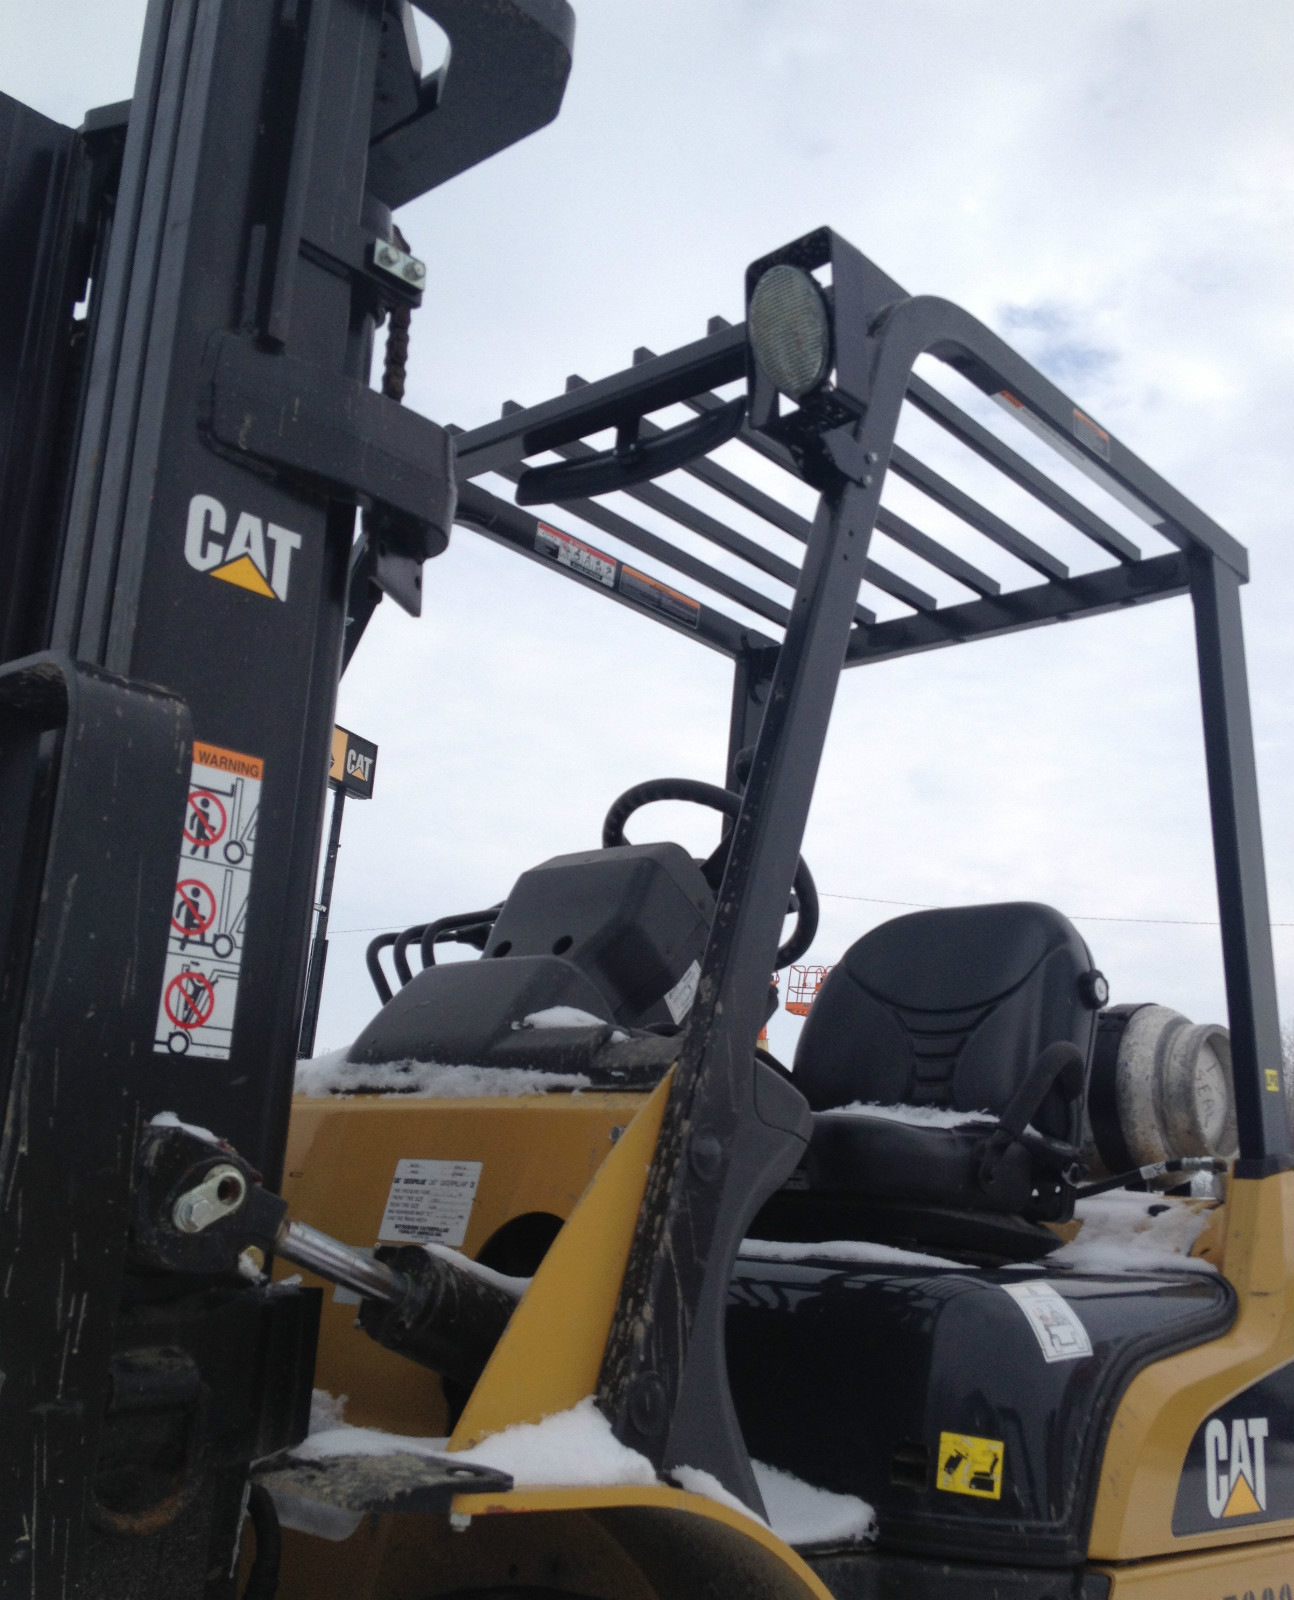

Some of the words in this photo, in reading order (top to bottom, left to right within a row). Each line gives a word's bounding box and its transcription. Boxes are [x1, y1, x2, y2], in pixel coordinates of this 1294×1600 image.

[184, 494, 302, 602] CAT
[199, 750, 259, 778] WARNING
[347, 749, 374, 782] CAT
[1205, 1418, 1269, 1519] CAT
